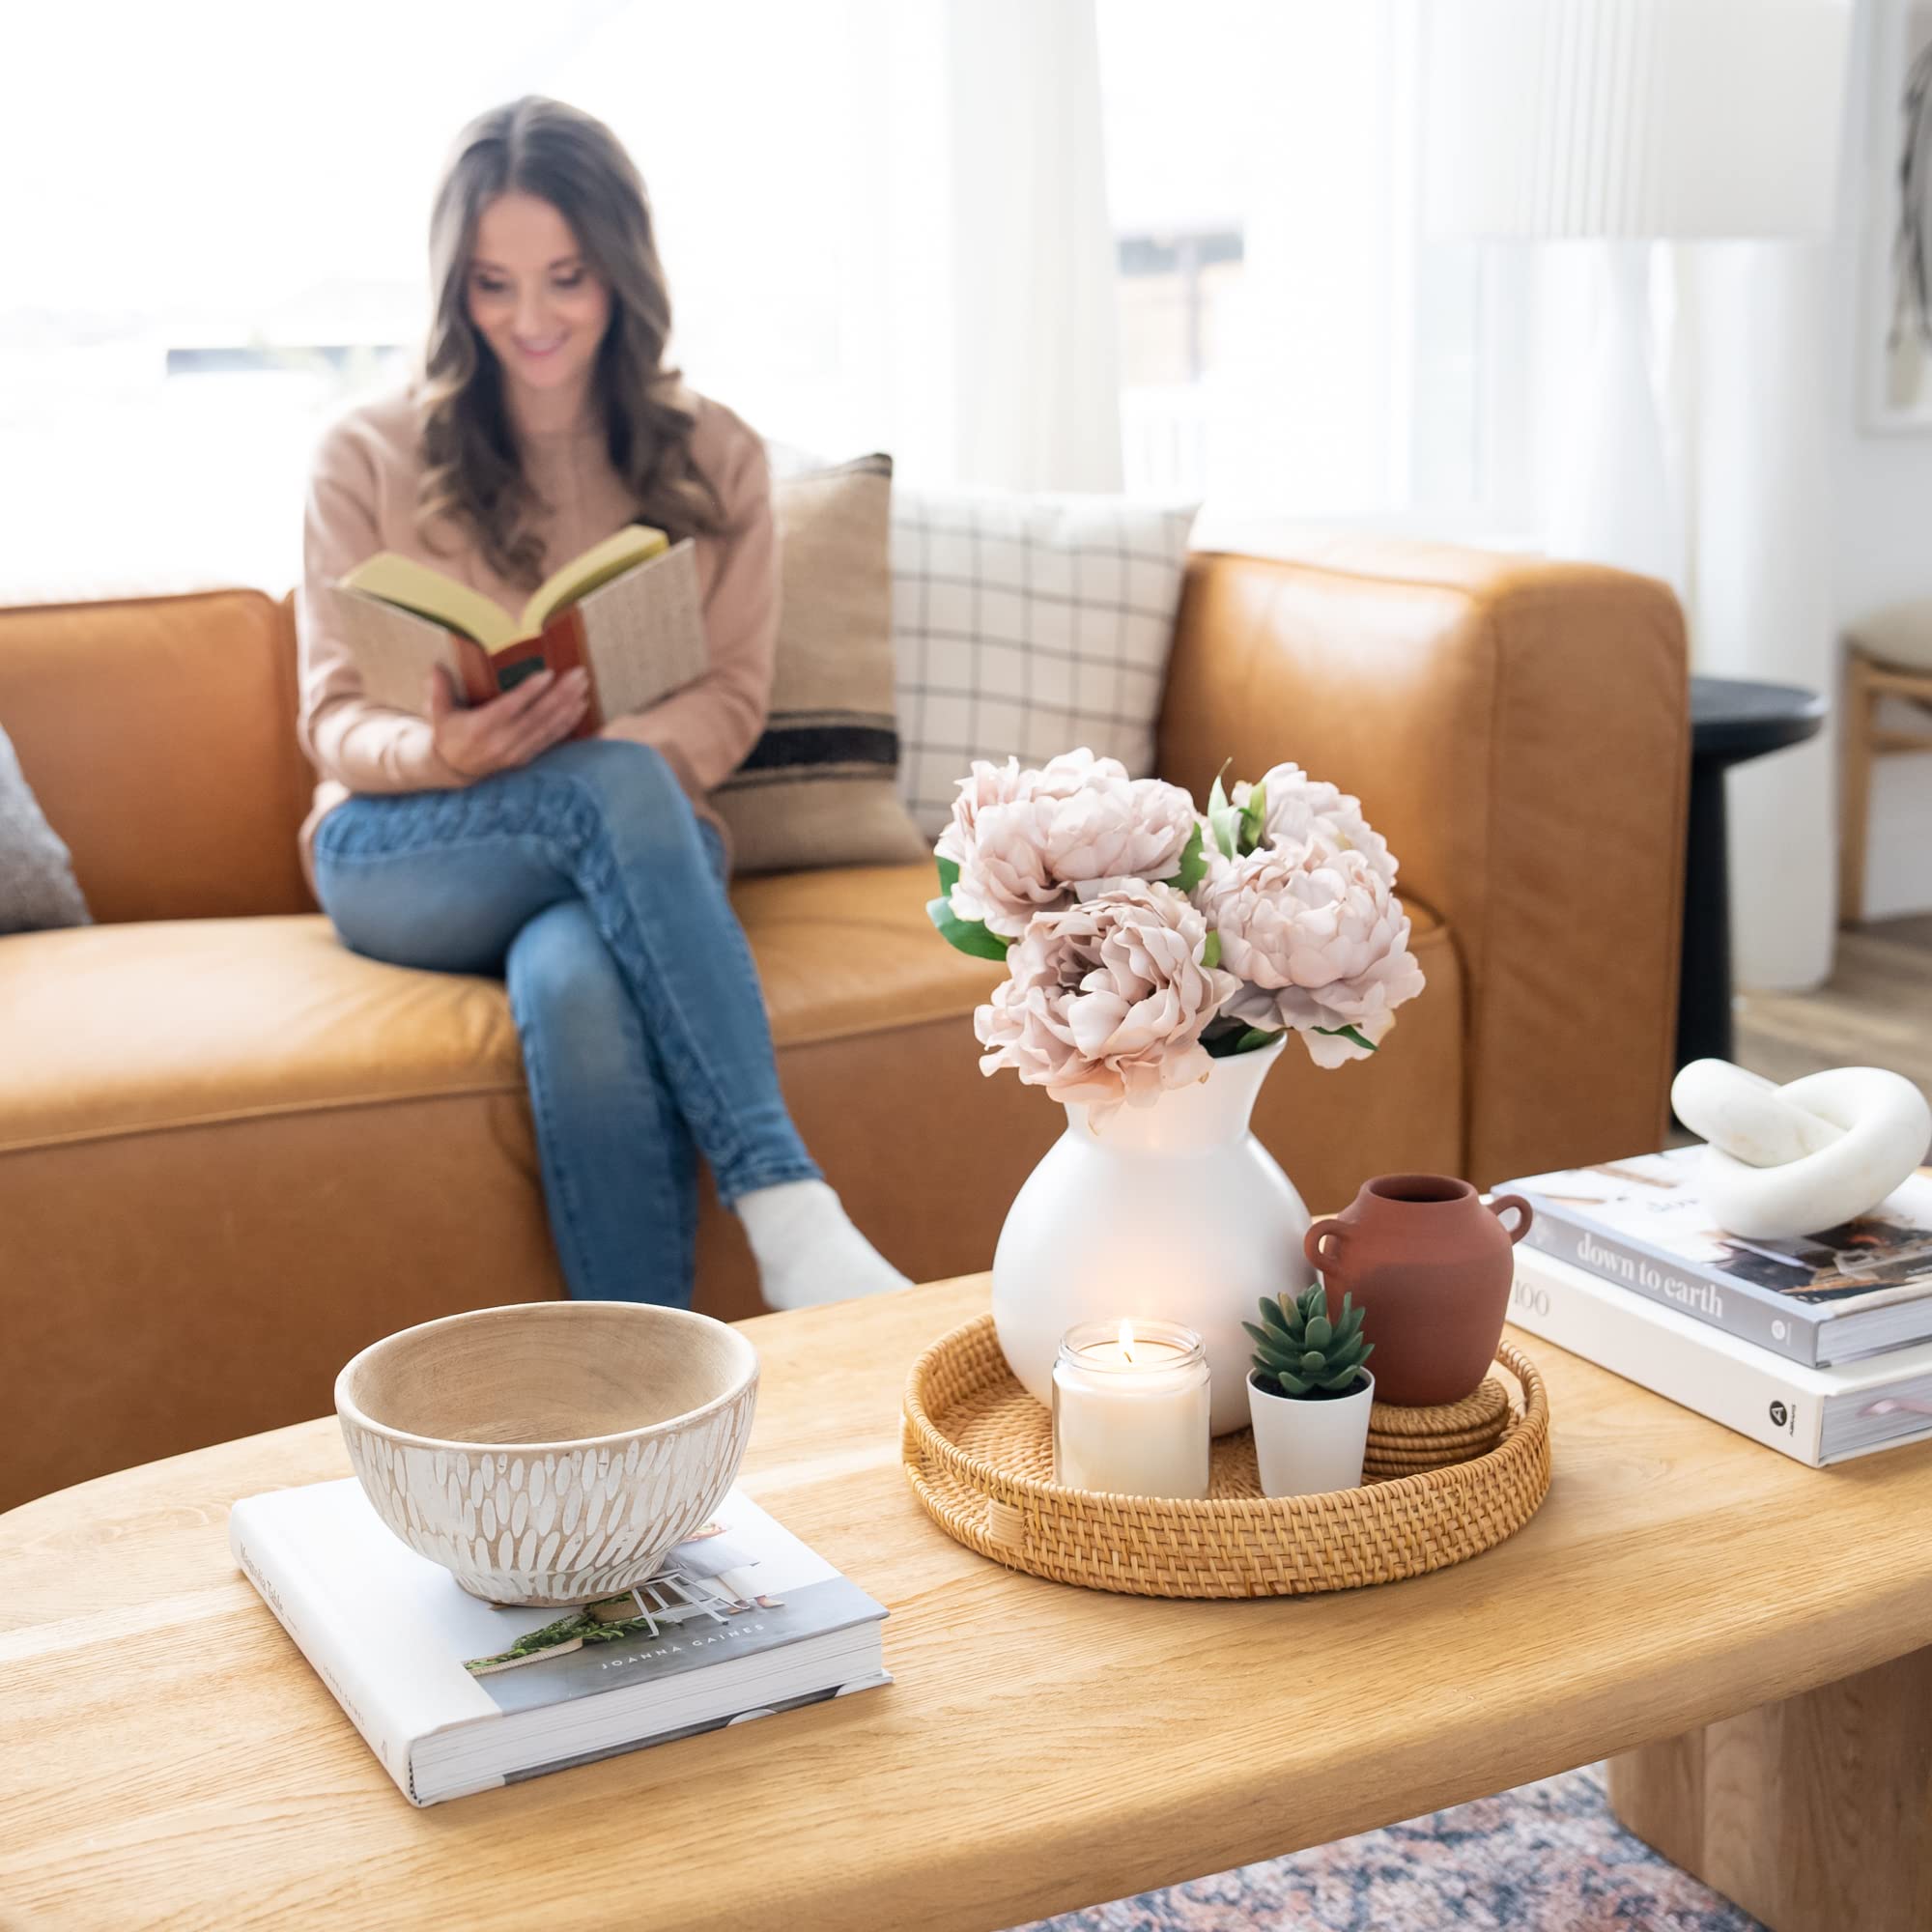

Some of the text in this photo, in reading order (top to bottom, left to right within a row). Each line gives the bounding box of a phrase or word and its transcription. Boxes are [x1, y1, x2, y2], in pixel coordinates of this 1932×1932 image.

[1514, 1278, 1550, 1317] 100
[1577, 1232, 1723, 1319] down to earth
[602, 1624, 765, 1670] JOANNA GAINES
